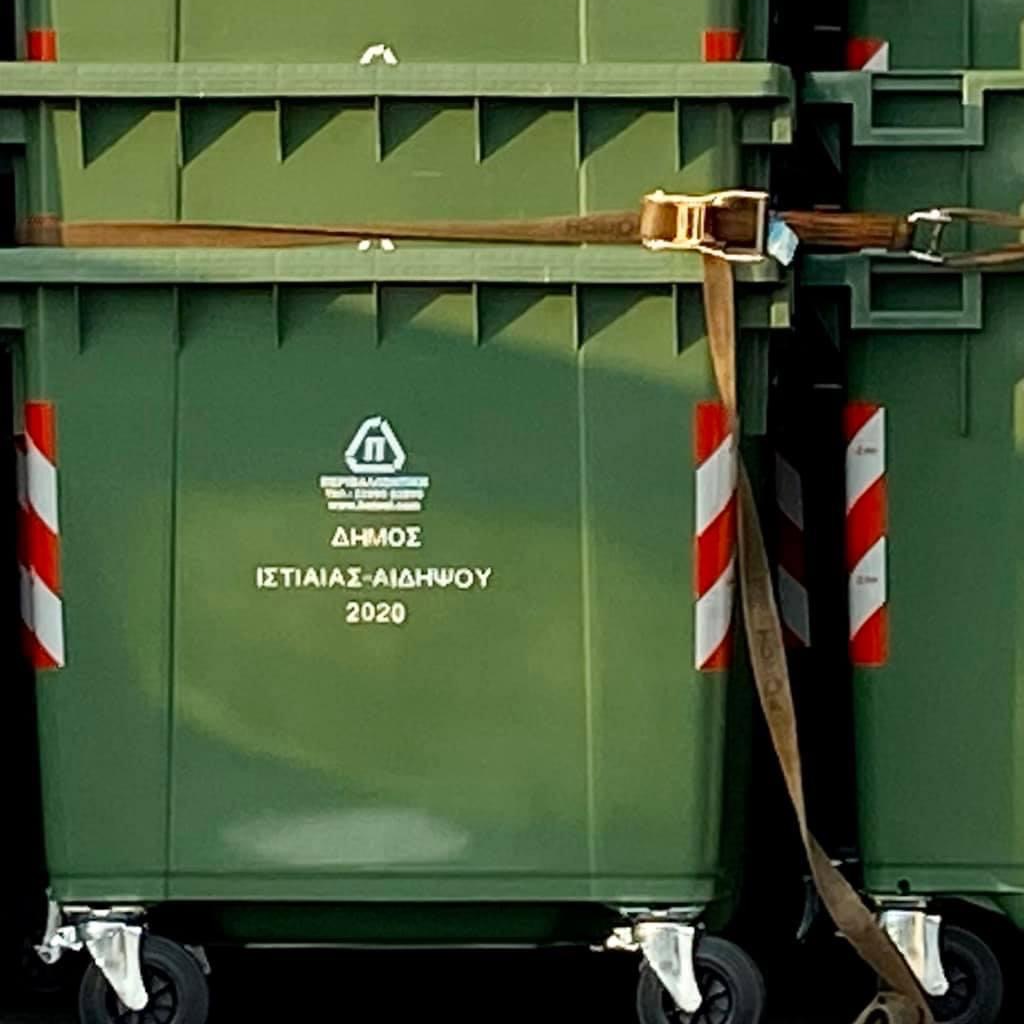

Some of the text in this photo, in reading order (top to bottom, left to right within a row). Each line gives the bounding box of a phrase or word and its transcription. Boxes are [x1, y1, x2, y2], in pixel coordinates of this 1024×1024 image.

[331, 526, 422, 548] ΔΗΜΟΣ
[256, 566, 492, 589] ΙΣΤΙΑΙΑΣ-ΑΙΔΗΨΟΥ
[345, 602, 406, 625] 2020
